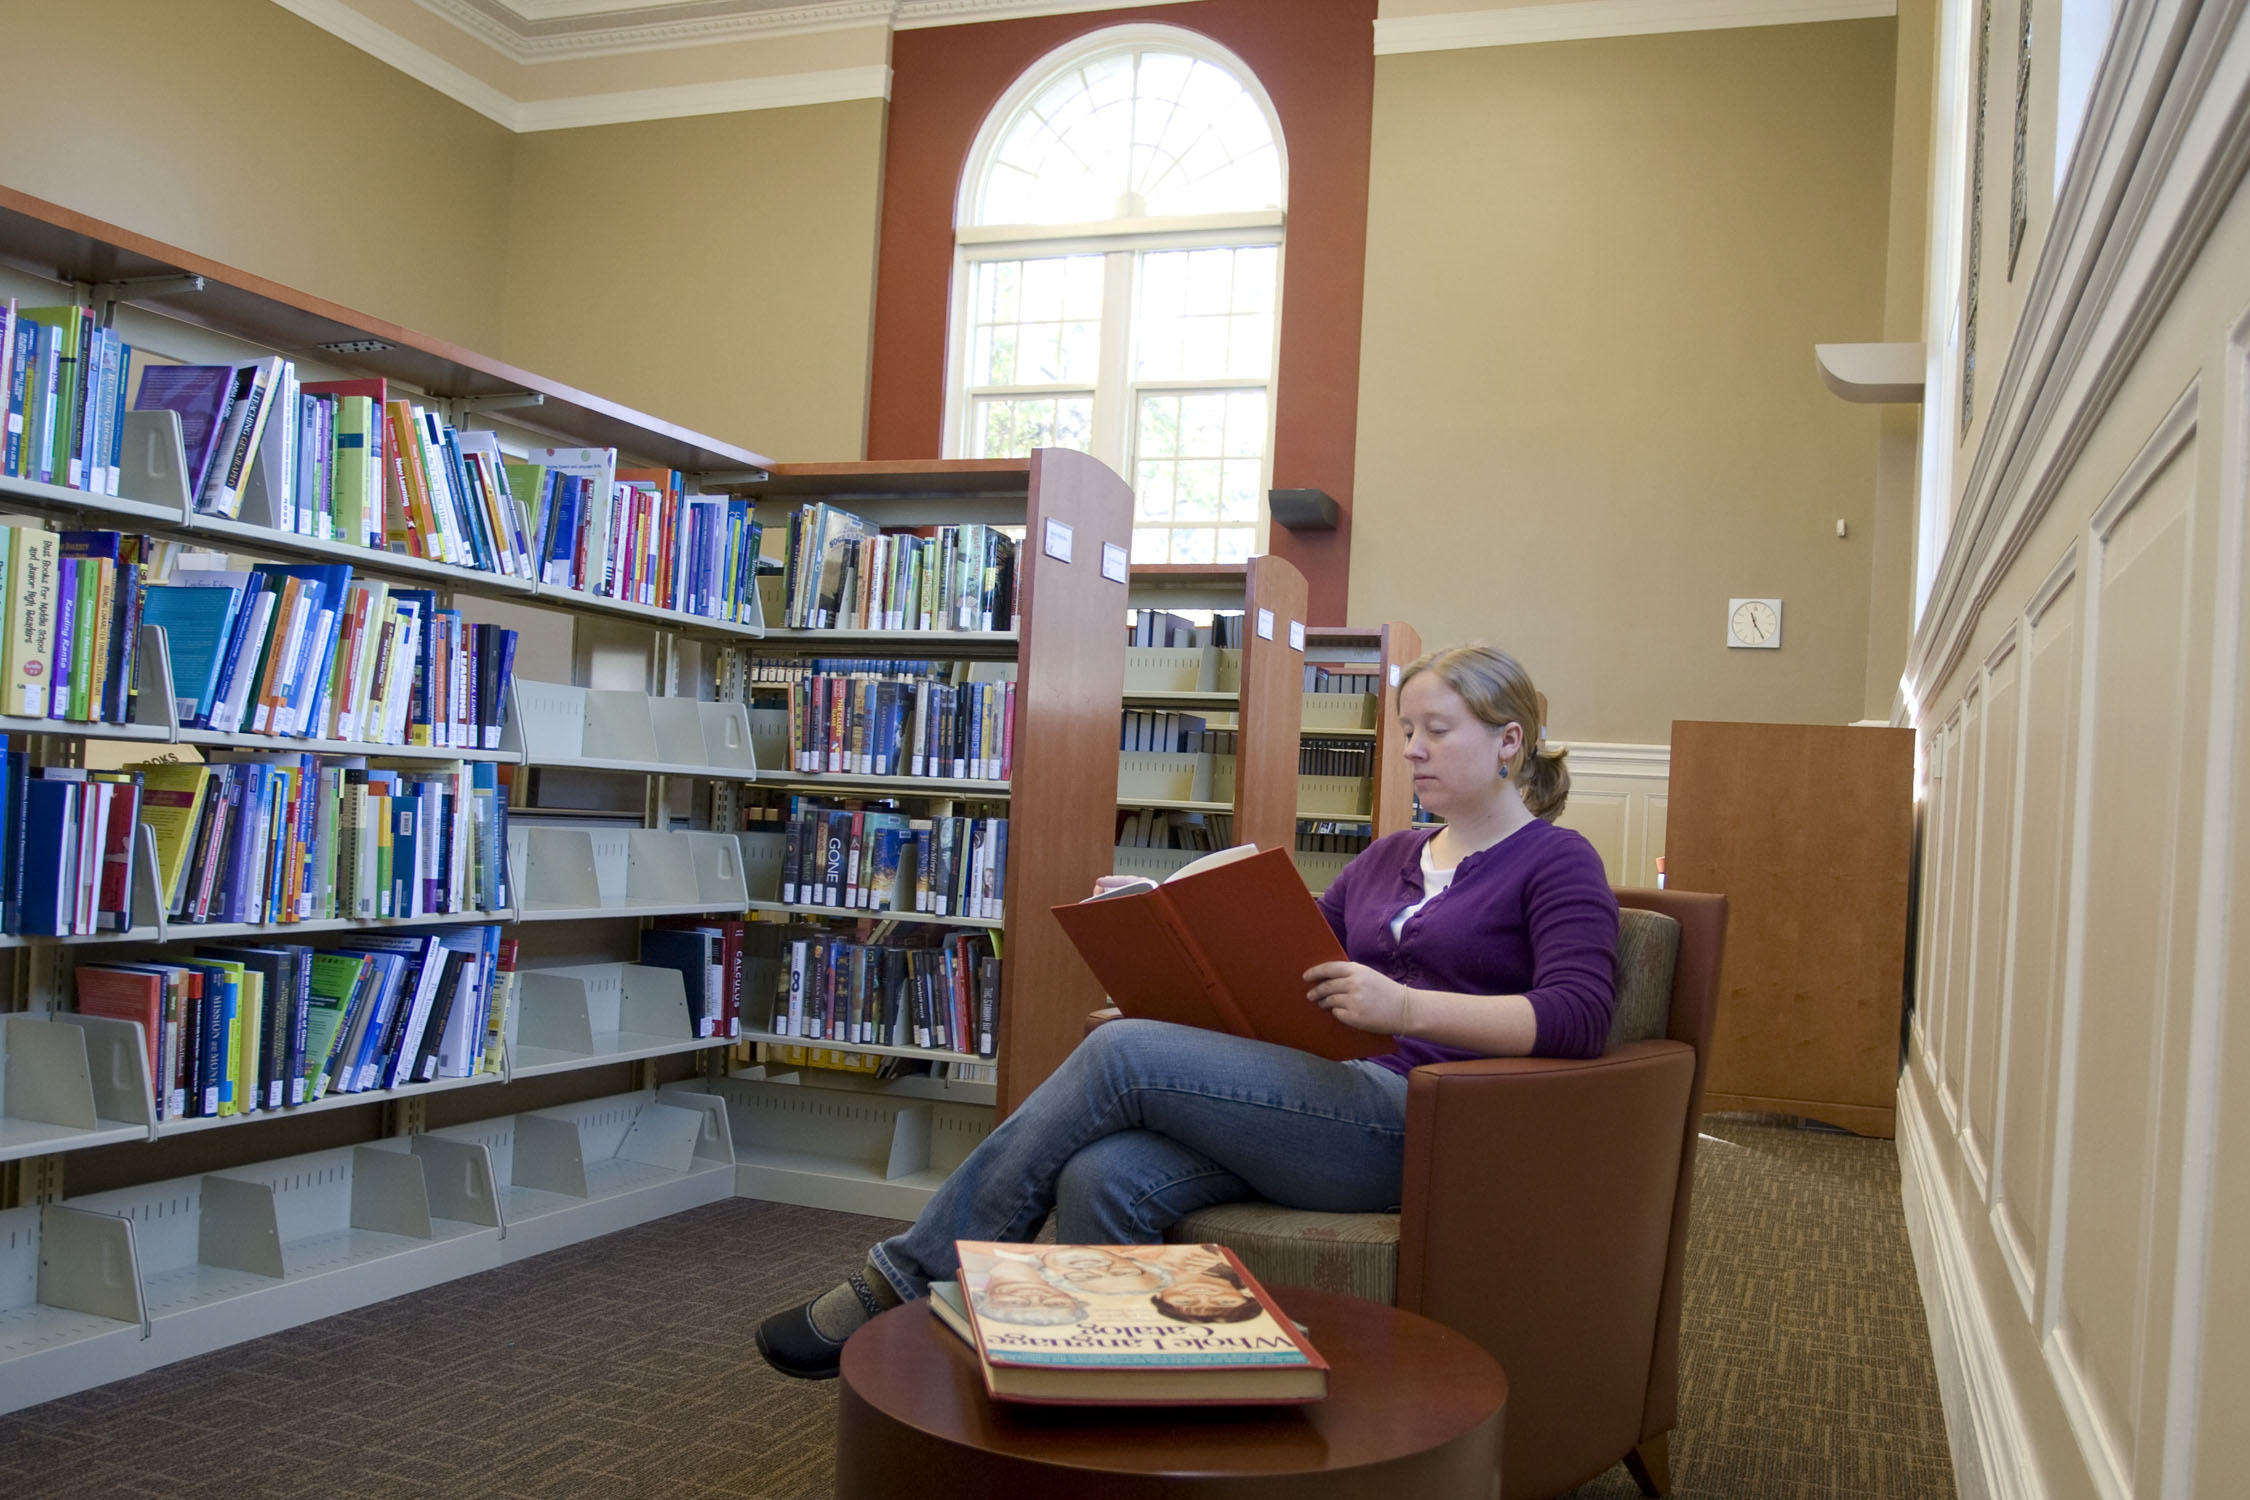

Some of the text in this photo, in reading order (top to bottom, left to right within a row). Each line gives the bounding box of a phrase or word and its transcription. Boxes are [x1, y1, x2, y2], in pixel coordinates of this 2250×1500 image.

[227, 395, 261, 489] TEACHING GEOGRAPHY
[395, 458, 410, 507] New Learning
[29, 546, 39, 561] and
[43, 540, 52, 558] Best
[27, 563, 37, 589] Junior
[41, 560, 51, 584] Books
[24, 609, 34, 644] Readers
[38, 602, 48, 627] Middle
[37, 629, 47, 653] School
[60, 599, 73, 669] Reading Rants
[459, 651, 468, 719] LEARNING
[972, 725, 980, 755] INSIDE
[827, 838, 841, 883] GONE
[734, 951, 743, 1008] CALCULUS
[211, 995, 222, 1039] MISSION
[302, 1001, 310, 1017] Edge
[987, 1335, 1298, 1350] Whole Language
[1077, 1323, 1215, 1337] Catalog
